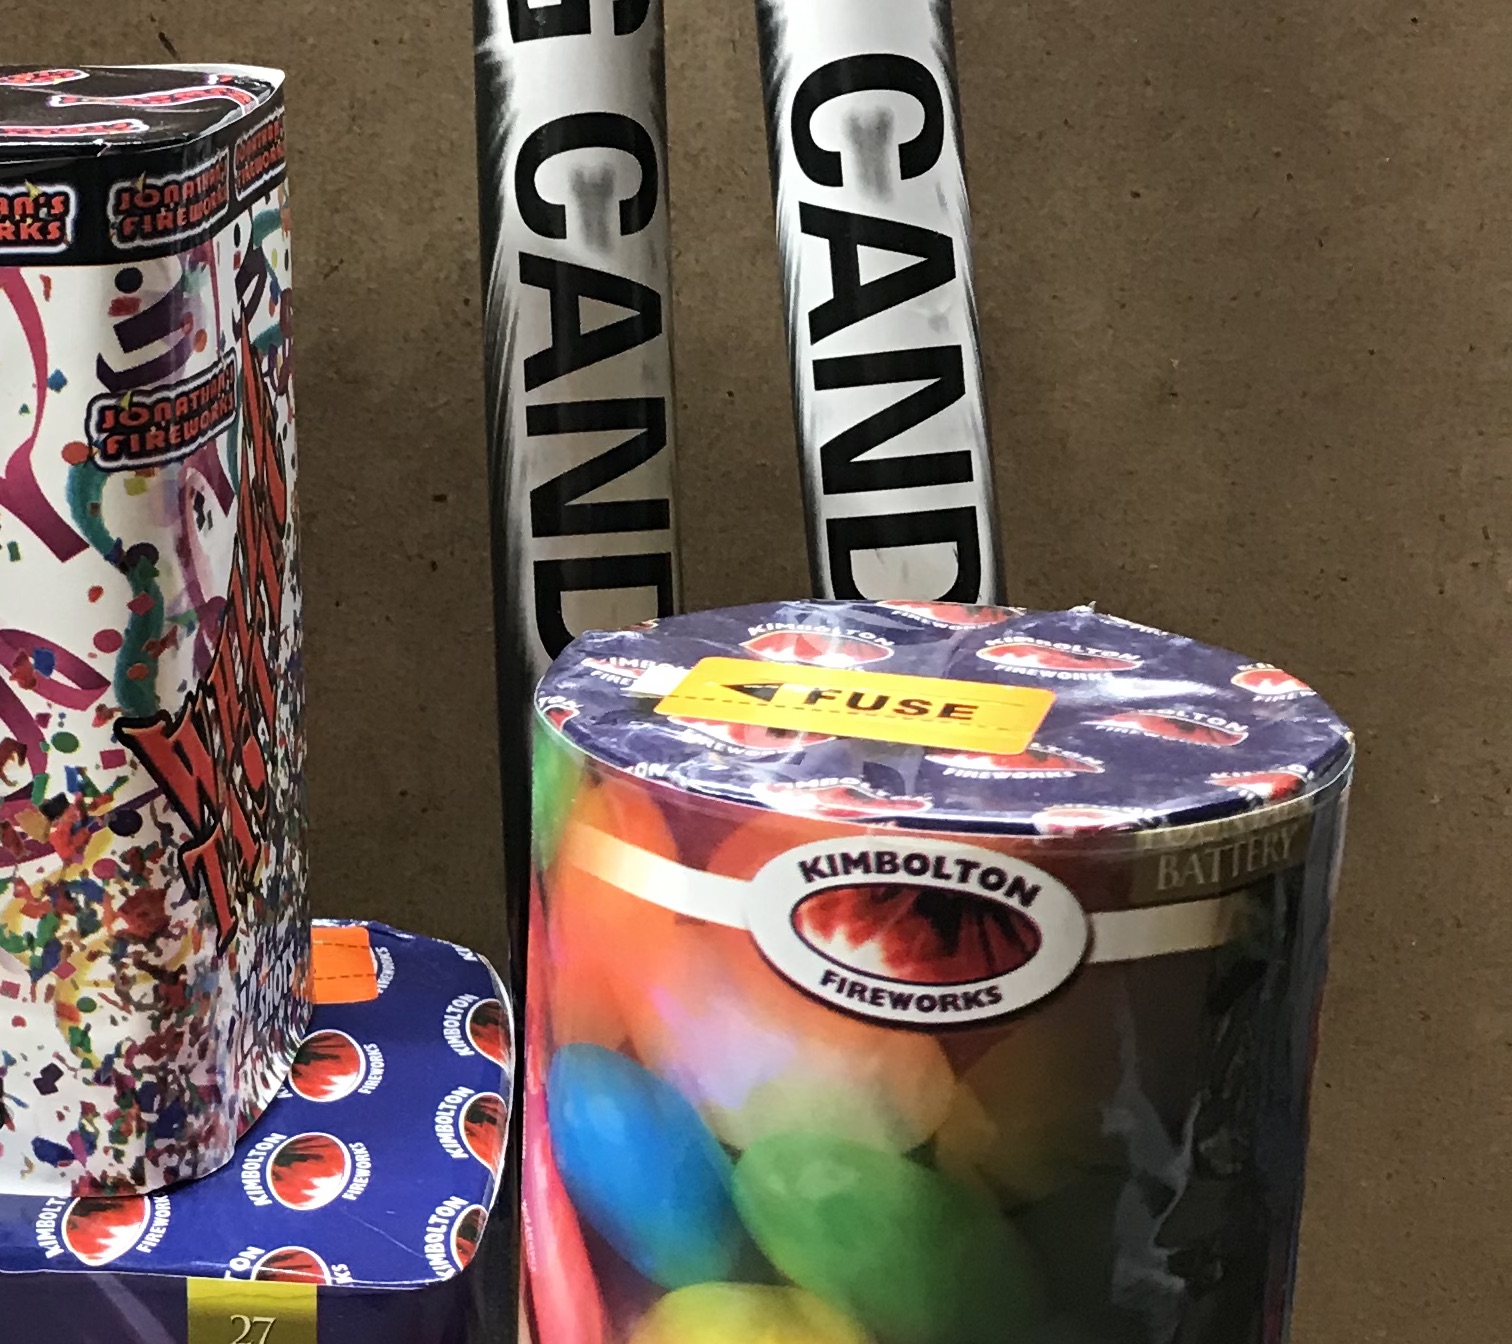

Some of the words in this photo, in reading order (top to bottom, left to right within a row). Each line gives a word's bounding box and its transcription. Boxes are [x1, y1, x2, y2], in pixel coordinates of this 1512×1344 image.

[803, 687, 980, 722] FUSE
[797, 850, 1044, 910] KIMBOLTON
[1156, 824, 1299, 891] BATTERY
[820, 969, 1003, 1015] FIREWORKS
[442, 991, 480, 1058] KIMBOLTON
[434, 1085, 476, 1160] KIMBOLTON
[240, 1132, 288, 1207] KIMBOLTON
[341, 1141, 372, 1202] FIREWORKS
